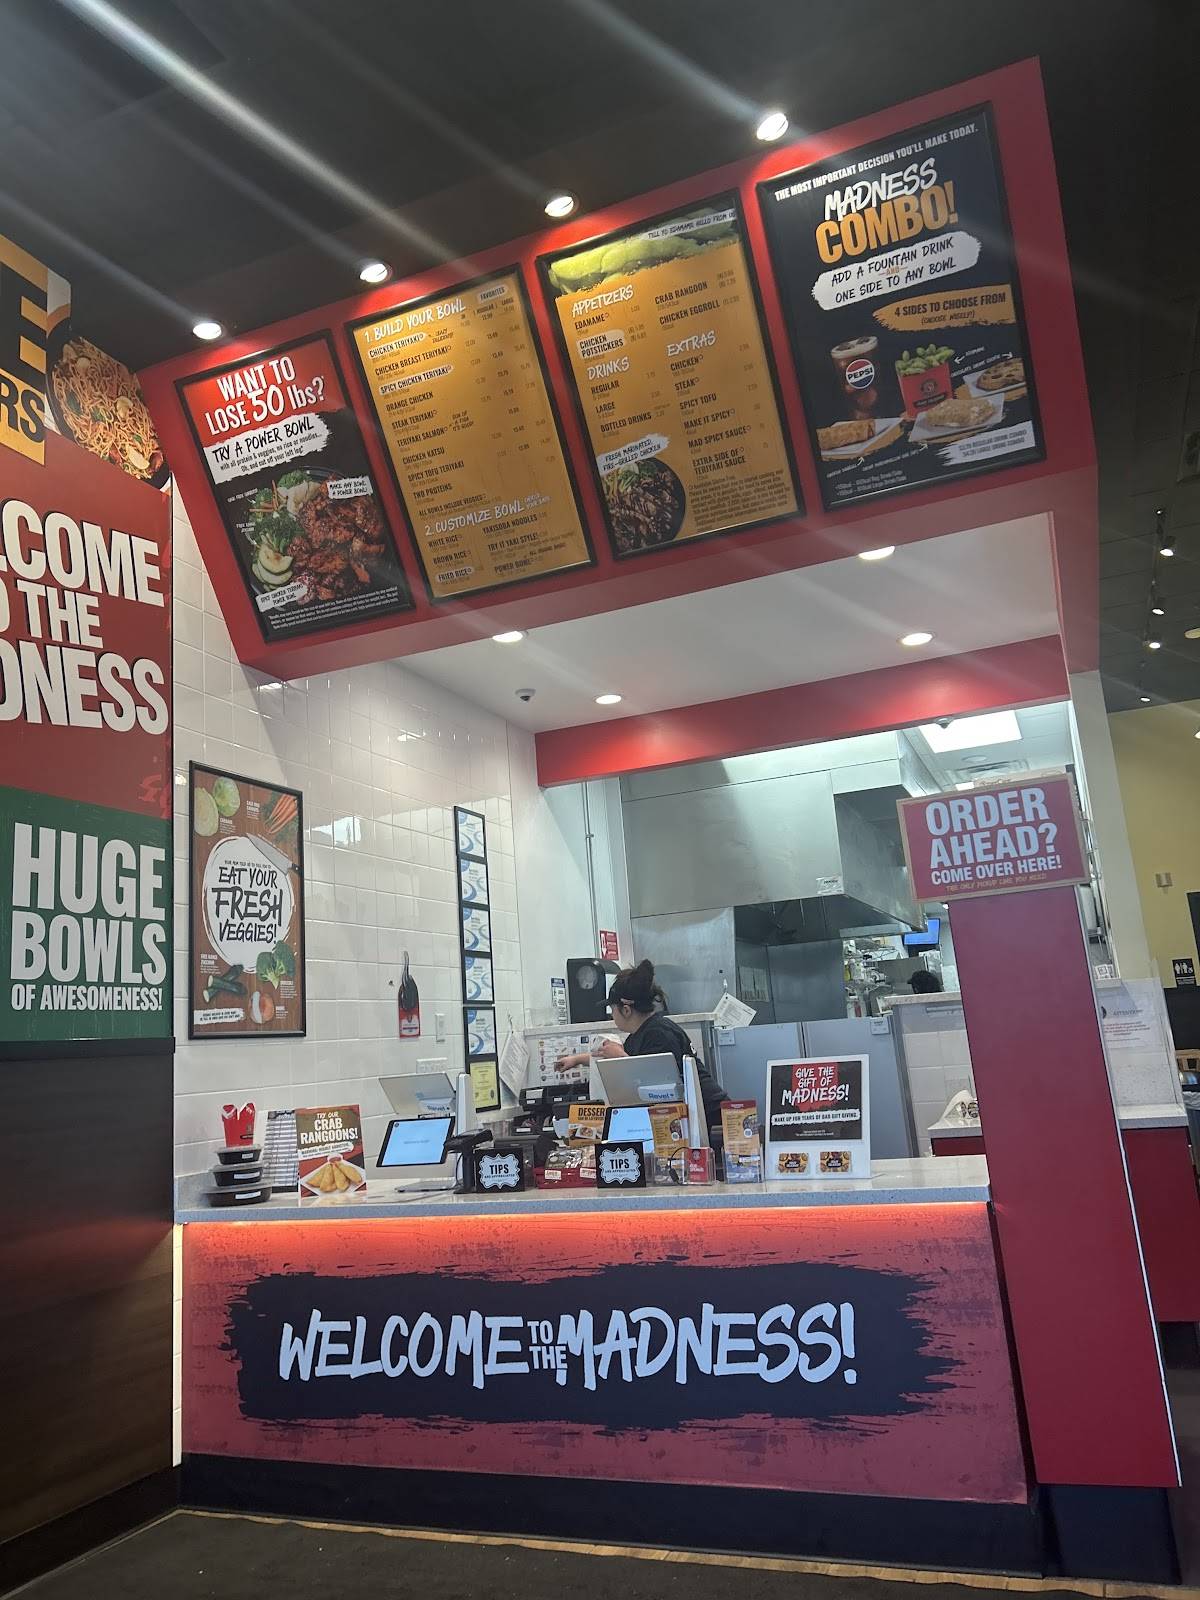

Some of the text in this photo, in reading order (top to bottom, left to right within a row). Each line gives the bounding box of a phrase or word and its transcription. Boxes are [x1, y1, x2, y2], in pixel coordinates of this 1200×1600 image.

[775, 123, 979, 201] THE MOST IMPORTANT DECISION YOU'LL MAKE TODAY.
[825, 157, 938, 221] MADNESS
[713, 214, 726, 222] FROM
[815, 180, 959, 264] COMBO!
[832, 237, 954, 287] ADD A FOUNTAIN DRINK
[835, 257, 957, 303] ONE SIDE TO ANY BOWL
[571, 284, 634, 318] APPETIZERS
[654, 282, 708, 305] CRAB RANGOON
[894, 292, 1006, 317] 4 SIDES TO CHOOSE FROM
[374, 321, 404, 341] BUILD
[407, 310, 434, 330] YOUR
[435, 298, 466, 320] BOWL
[574, 313, 605, 330] EDAMAME
[659, 309, 689, 325] CHICKEN
[690, 300, 720, 317] EGGROLL
[369, 334, 420, 358] CHICKEN TERIYAKI
[579, 335, 607, 349] CHICKEN
[581, 339, 623, 357] POTSTICKERS
[667, 331, 716, 356] EXTRAS
[375, 346, 448, 376] CHICKEN BREAST TERIYAKI
[586, 356, 630, 381] DRINKS
[670, 357, 699, 371] CHICKEN
[217, 356, 296, 402] WANT TO
[380, 368, 448, 394] SPICY CHICKEN TERIYAKI
[847, 367, 873, 380] PEPSI
[591, 380, 619, 395] REGULAR
[675, 380, 695, 391] STEAK
[205, 401, 250, 436] LOSE
[247, 384, 284, 422] 50
[386, 391, 434, 411] ORANGE CHICKEN
[595, 402, 615, 413] LARGE
[680, 393, 716, 409] SPICY TOFU
[392, 412, 434, 429] STEAK TERIYAKI
[601, 412, 651, 432] BOTTLED DRINKS
[684, 410, 730, 429] MAKE IT SPICY
[212, 417, 314, 463] TRY A POWER BOWL
[397, 429, 445, 447] TERIYAKI SALMON
[688, 426, 747, 449] MAD SPICY SAUCE
[402, 447, 445, 464] CHICKEN KATSU
[692, 449, 739, 467] EXTRA SIDE OF
[694, 457, 746, 475] TERIYAKI SAUCE
[408, 461, 464, 482] SPICY TOFU TERIYAKI
[413, 483, 453, 499] TWO PROTEINS
[435, 510, 491, 535] CUSTOMIZE
[495, 500, 525, 520] BOWL
[512, 514, 538, 528] NOODLES
[428, 534, 459, 548] WHITE RICE
[0, 500, 164, 607] COME
[453, 550, 467, 560] RICE
[438, 568, 468, 582] FRIED RICE
[17, 579, 103, 649] THE
[925, 787, 1050, 836] ORDER
[930, 823, 1058, 869] AHEAD?
[12, 822, 165, 921] HUGE
[219, 866, 278, 889] EAT YOUR
[931, 855, 1062, 885] COME OVER HERE!
[211, 886, 283, 927] FRESH
[219, 918, 277, 944] VEGGIES!
[10, 910, 167, 985] BOWLS
[11, 983, 162, 1011] OF AWESOMENESS!
[795, 1066, 835, 1078] GIVE THE
[798, 1076, 833, 1088] GIFT OF
[781, 1084, 850, 1106] MADNESS!
[578, 1107, 605, 1118] DESSER
[314, 1118, 342, 1131] CRAB
[300, 1128, 358, 1144] RANGOONS!
[489, 1164, 509, 1175] TIPS
[610, 1159, 629, 1170] TIPS
[278, 1301, 857, 1391] WELCOME TO THE MADNESS!
